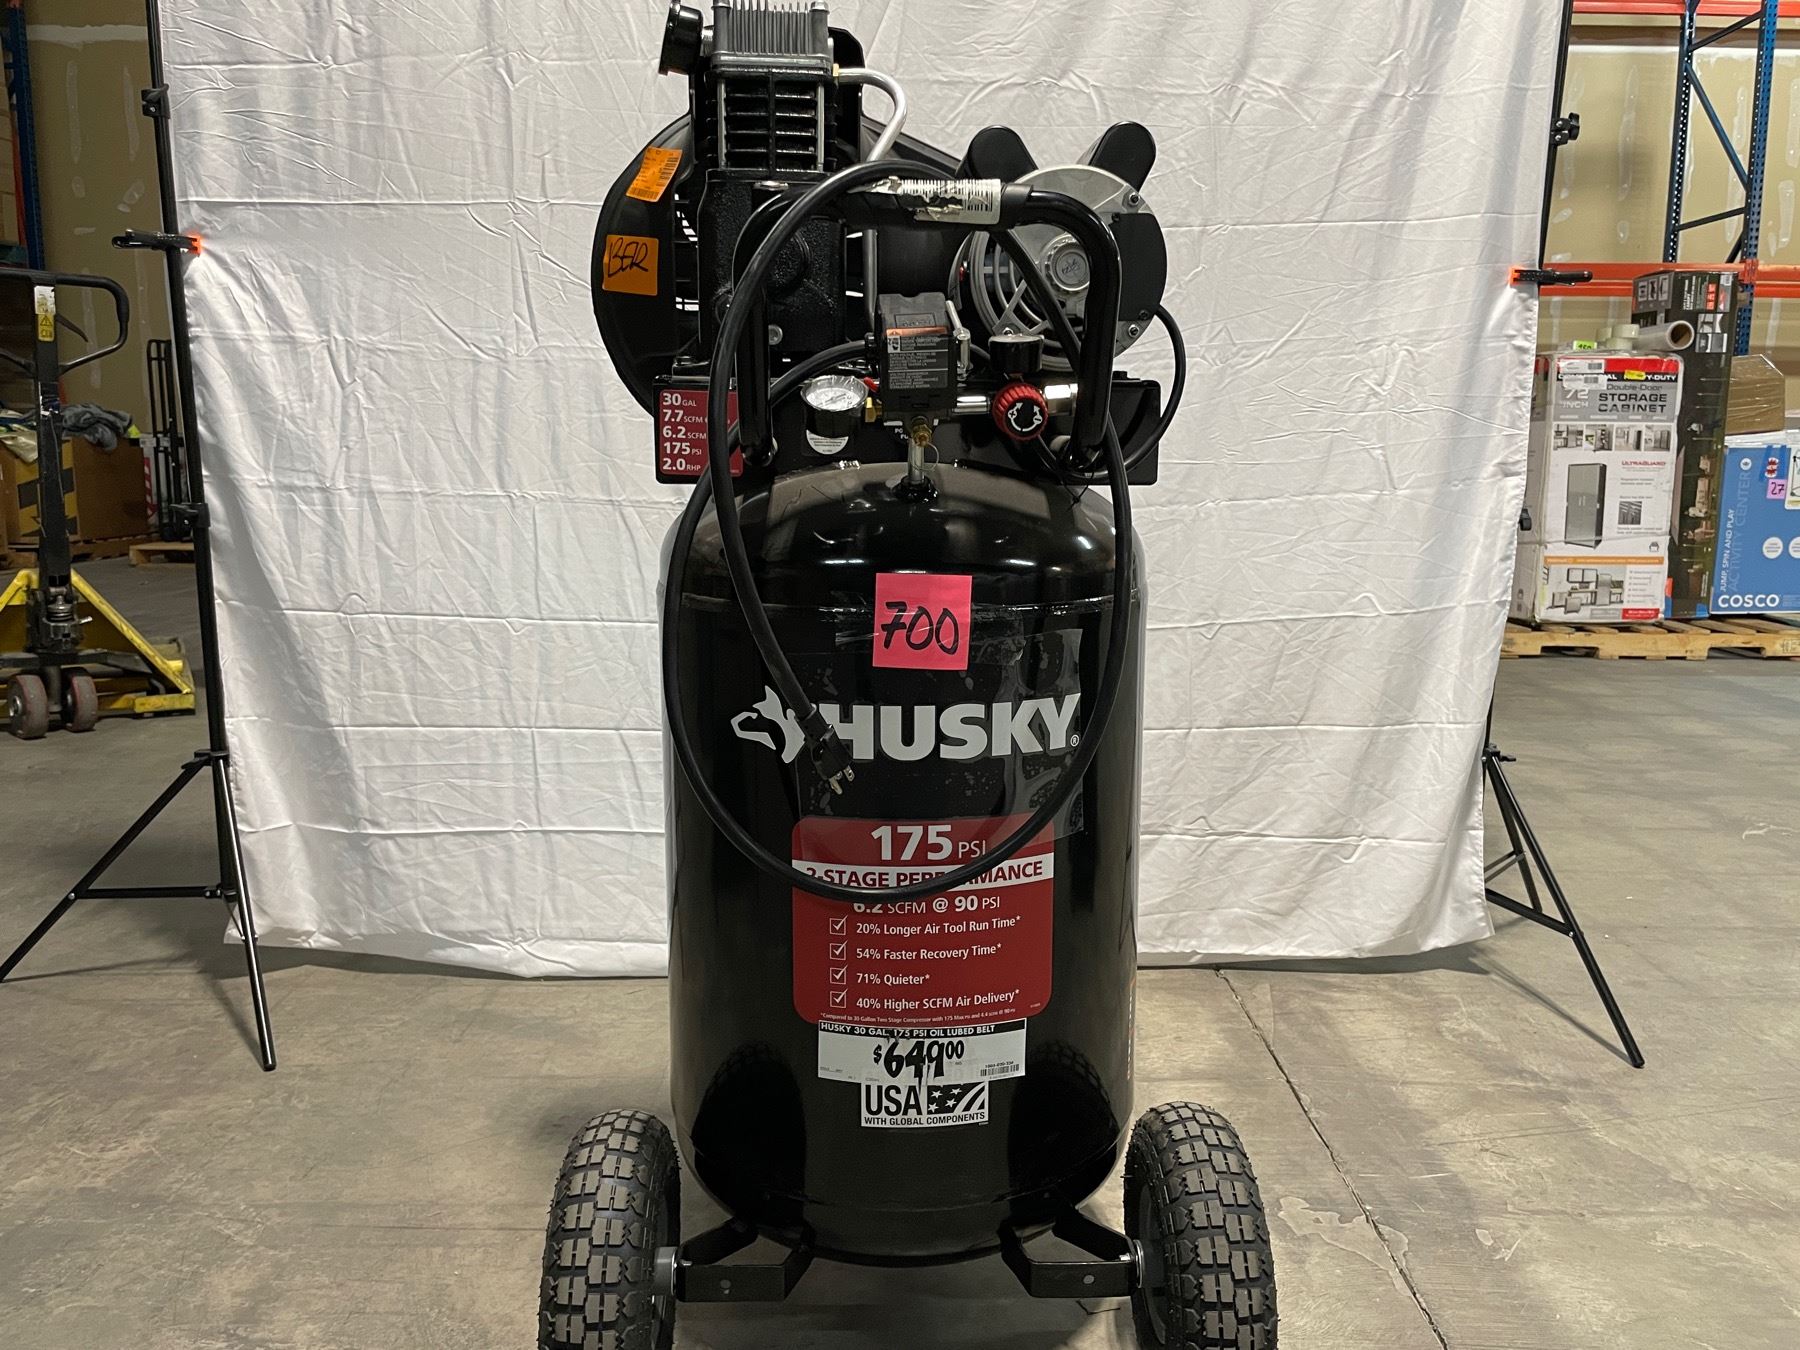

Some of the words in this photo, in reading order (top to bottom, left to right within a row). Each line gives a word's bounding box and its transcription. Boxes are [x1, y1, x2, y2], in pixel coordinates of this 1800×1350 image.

[662, 392, 682, 406] 30
[682, 399, 697, 407] GAL
[1598, 393, 1668, 402] STORAGE
[662, 409, 684, 422] 7.7
[1598, 404, 1667, 413] CABINET
[662, 426, 686, 439] 6.2
[663, 442, 691, 455] 175
[662, 458, 686, 470] 2.0
[1771, 482, 1785, 496] 27
[1734, 472, 1750, 527] CENTER
[1726, 508, 1735, 528] PLAY
[1724, 530, 1733, 549] AND
[1722, 548, 1731, 569] SPIN
[1728, 530, 1743, 592] ACTIVITY
[1718, 594, 1779, 608] COSCO
[881, 601, 959, 655] 700
[871, 824, 953, 861] 175
[958, 840, 986, 859] PSI
[852, 902, 884, 914] 6.2
[888, 900, 926, 914] SCFM
[932, 897, 949, 913] @
[954, 895, 979, 912] 90
[982, 896, 1000, 909] PSI
[856, 923, 881, 935] 20%
[884, 923, 920, 938] Longer
[924, 922, 940, 934] Air
[943, 921, 966, 934] Tool
[969, 919, 989, 931] Run
[856, 948, 881, 960] 54%
[884, 948, 916, 960] Faster
[920, 946, 969, 963] Recovery
[856, 973, 881, 984] 71%
[856, 998, 881, 1010] 40%
[884, 998, 920, 1012] Higher
[922, 996, 953, 1009] SCFM
[956, 995, 971, 1006] Air
[821, 1022, 852, 1033] HUSKY
[853, 1027, 866, 1035] 30
[893, 1029, 910, 1037] 175
[913, 1029, 927, 1037] PSI
[929, 1029, 944, 1037] OIL
[947, 1027, 975, 1036] LUBED
[976, 1025, 995, 1034] BELT
[865, 1084, 922, 1116] USA
[864, 1116, 887, 1125] WITH
[889, 1117, 923, 1126] GLOBAL
[926, 1111, 985, 1125] COMPONENTS
